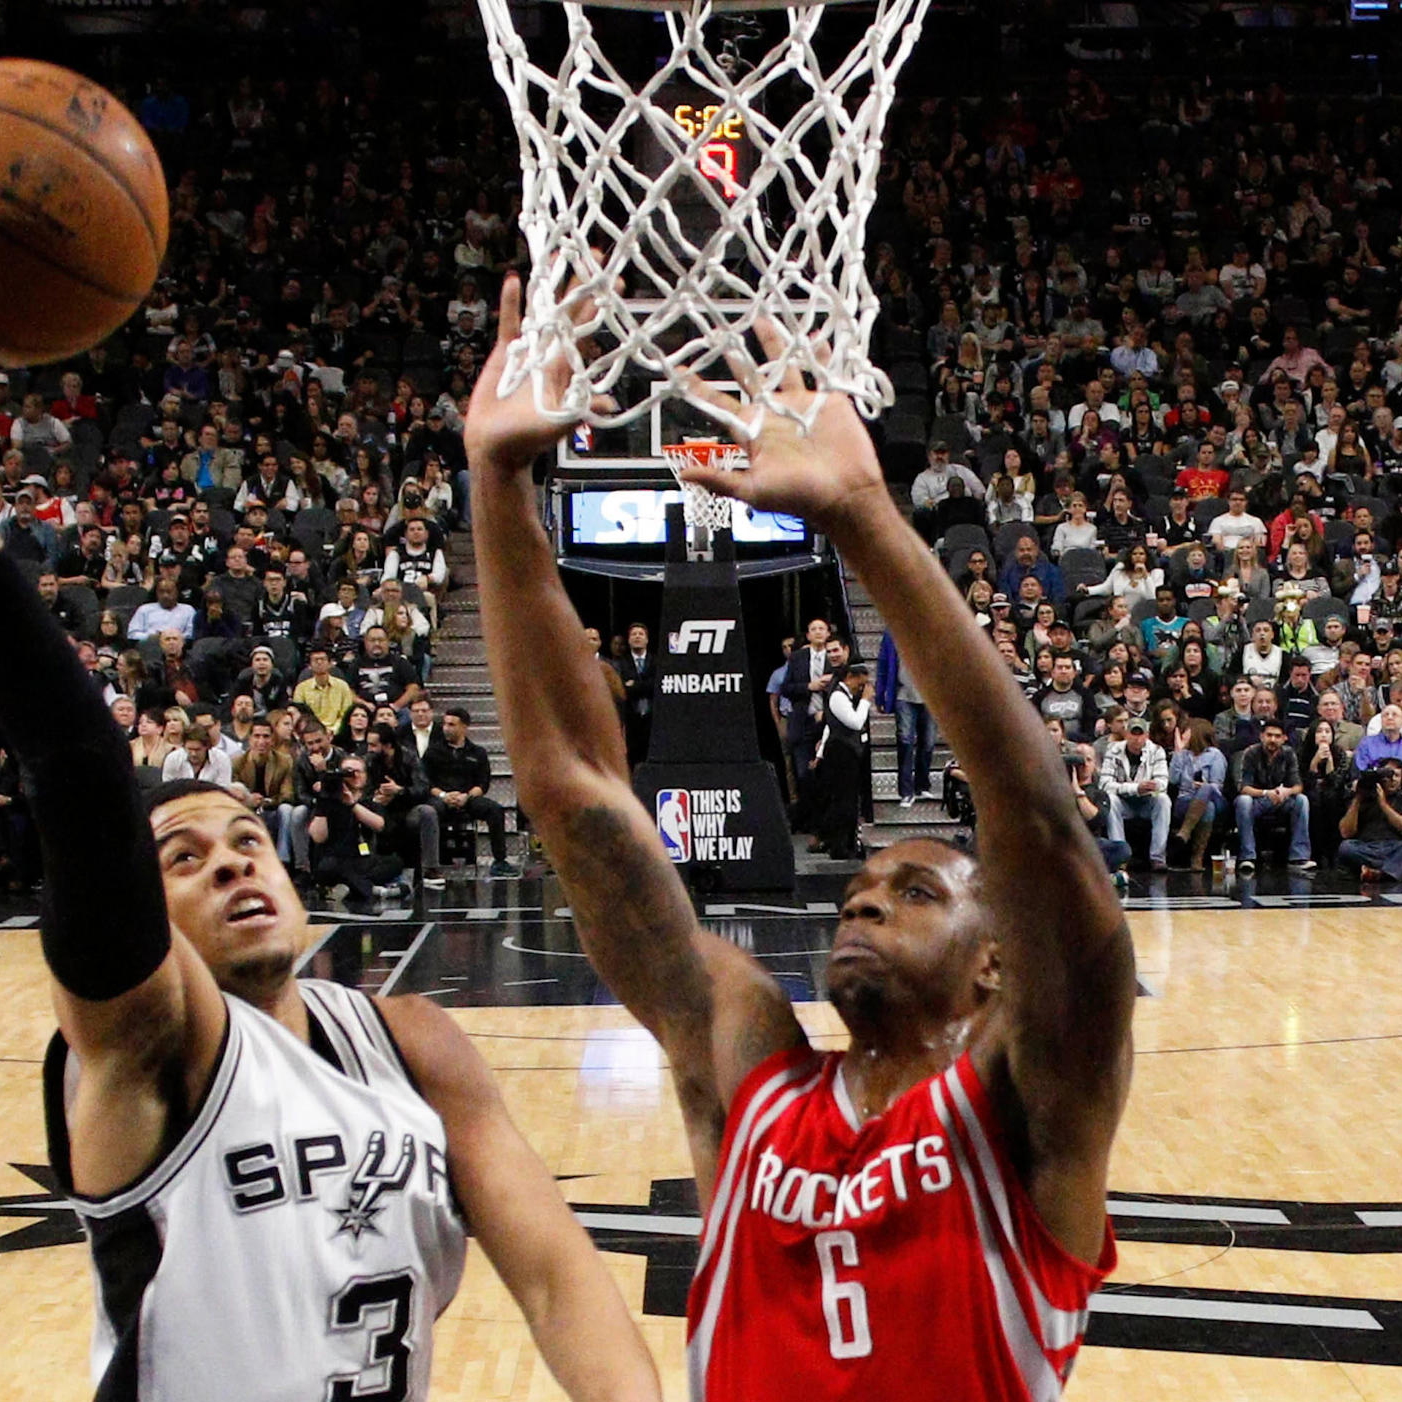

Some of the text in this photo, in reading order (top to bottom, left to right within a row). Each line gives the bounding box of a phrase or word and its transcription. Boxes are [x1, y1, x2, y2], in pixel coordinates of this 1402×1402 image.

[661, 673, 743, 694] #NBAFIT
[690, 789, 741, 814] THIS IS
[692, 813, 726, 837] WHY
[694, 836, 753, 861] WE PLAY
[222, 1130, 448, 1220] SPUR
[750, 1134, 954, 1228] ROCKETS
[813, 1229, 875, 1361] 6
